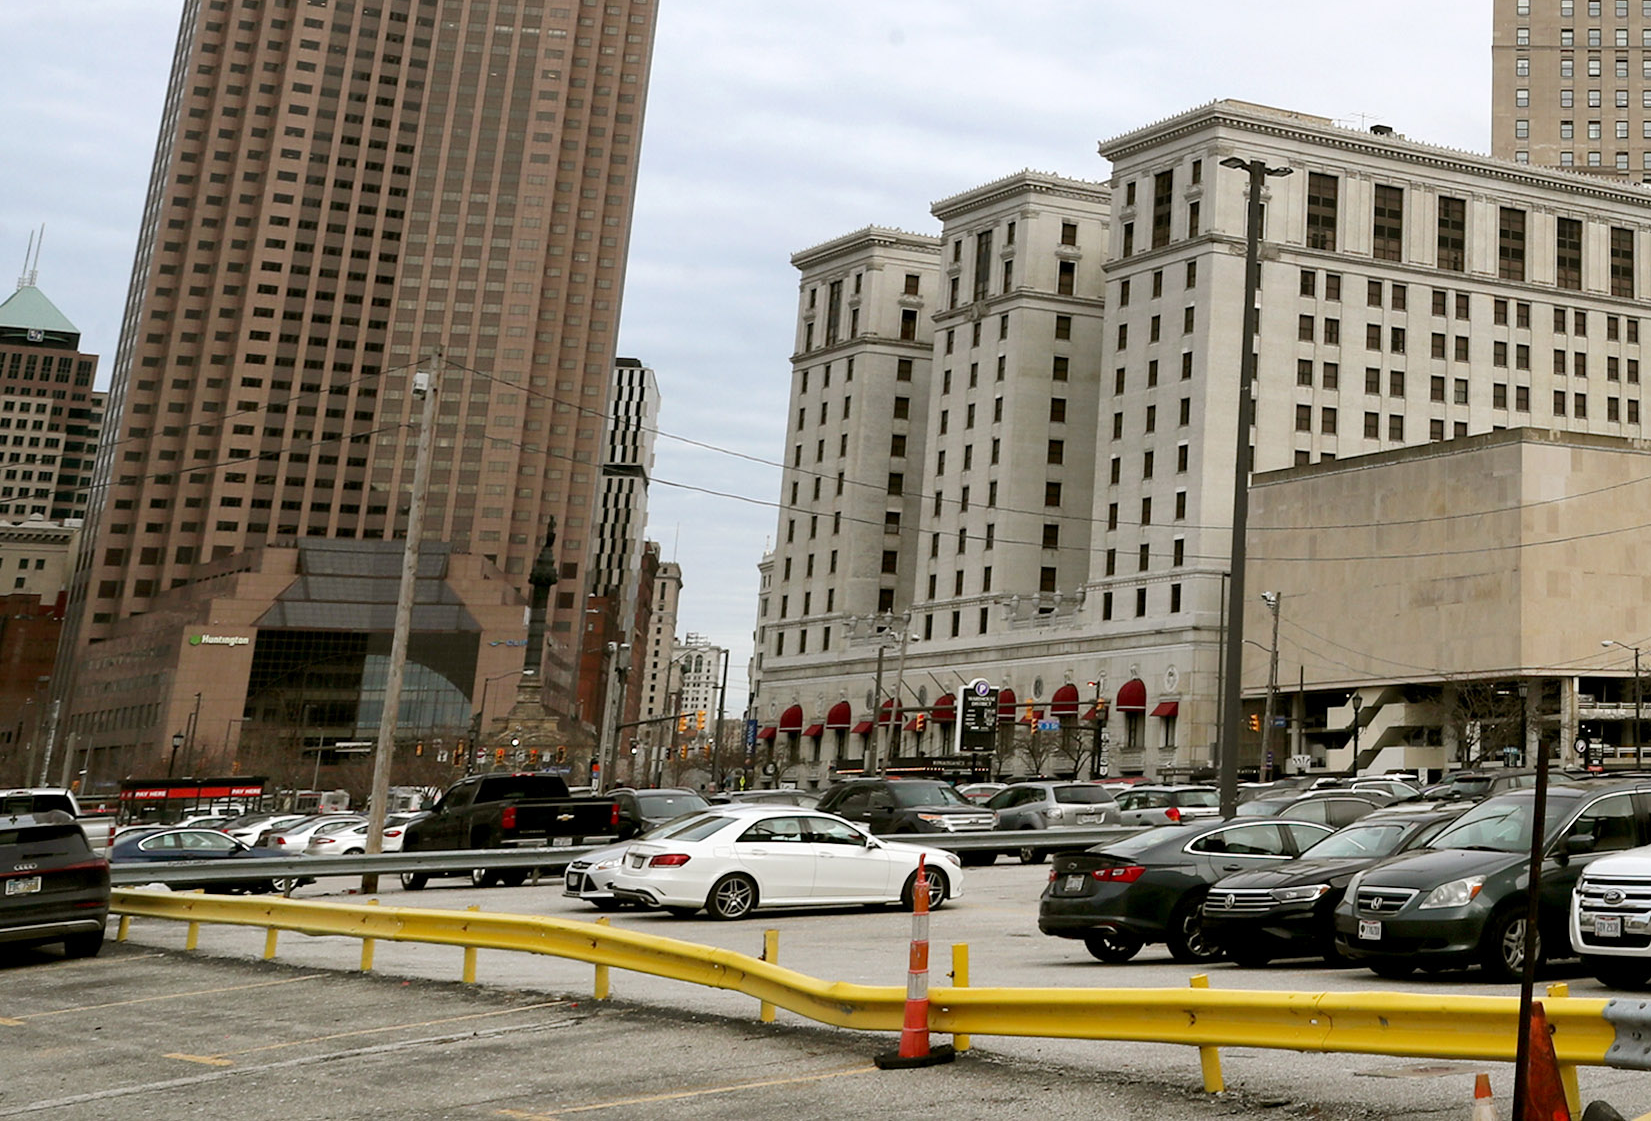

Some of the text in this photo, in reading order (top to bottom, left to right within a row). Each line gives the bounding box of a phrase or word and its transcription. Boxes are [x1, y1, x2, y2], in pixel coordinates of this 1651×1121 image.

[201, 635, 249, 647] Huntington
[979, 684, 987, 695] P
[134, 790, 148, 798] PAY
[245, 787, 262, 795] HERE
